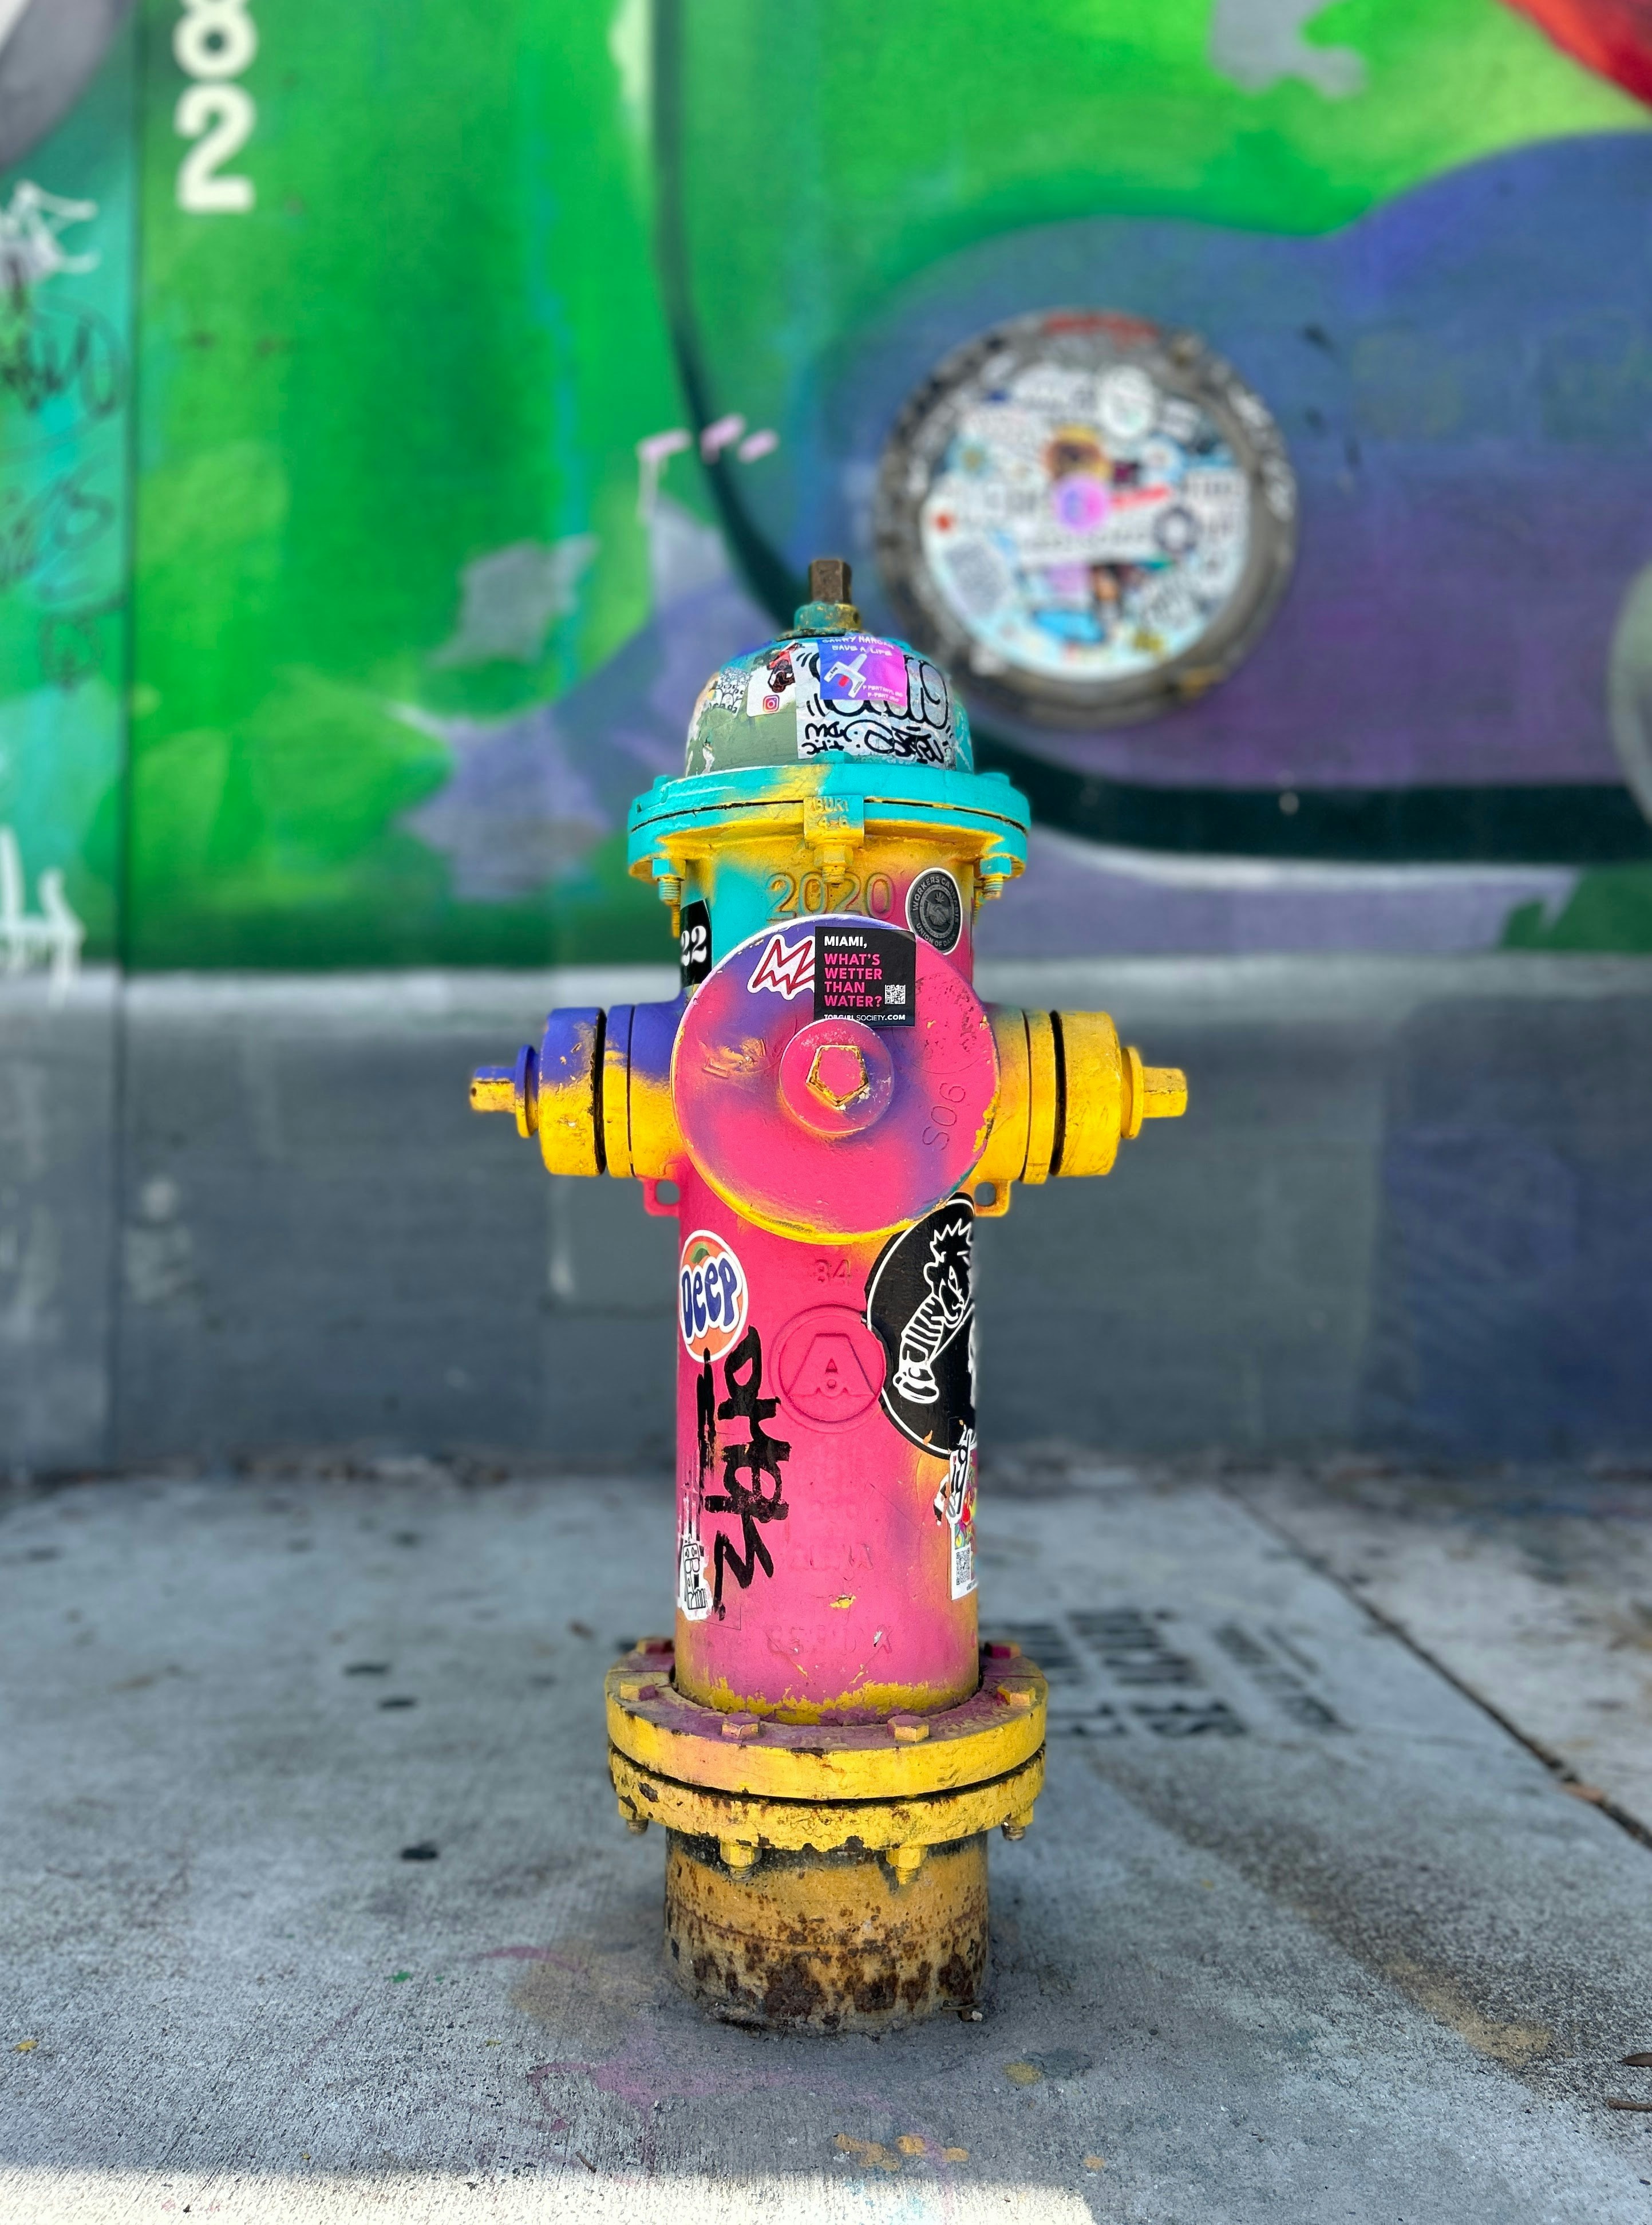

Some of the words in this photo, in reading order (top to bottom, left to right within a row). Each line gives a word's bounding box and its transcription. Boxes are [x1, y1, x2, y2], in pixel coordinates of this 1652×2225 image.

[765, 871, 896, 921] 2020
[912, 875, 940, 912] WORKERS
[916, 922, 934, 944] UNION
[824, 936, 868, 949] MIAMI,
[824, 953, 881, 966] WHAT'S
[824, 967, 883, 980] WETTER
[824, 981, 865, 993] THAN
[824, 995, 883, 1008] WATER?
